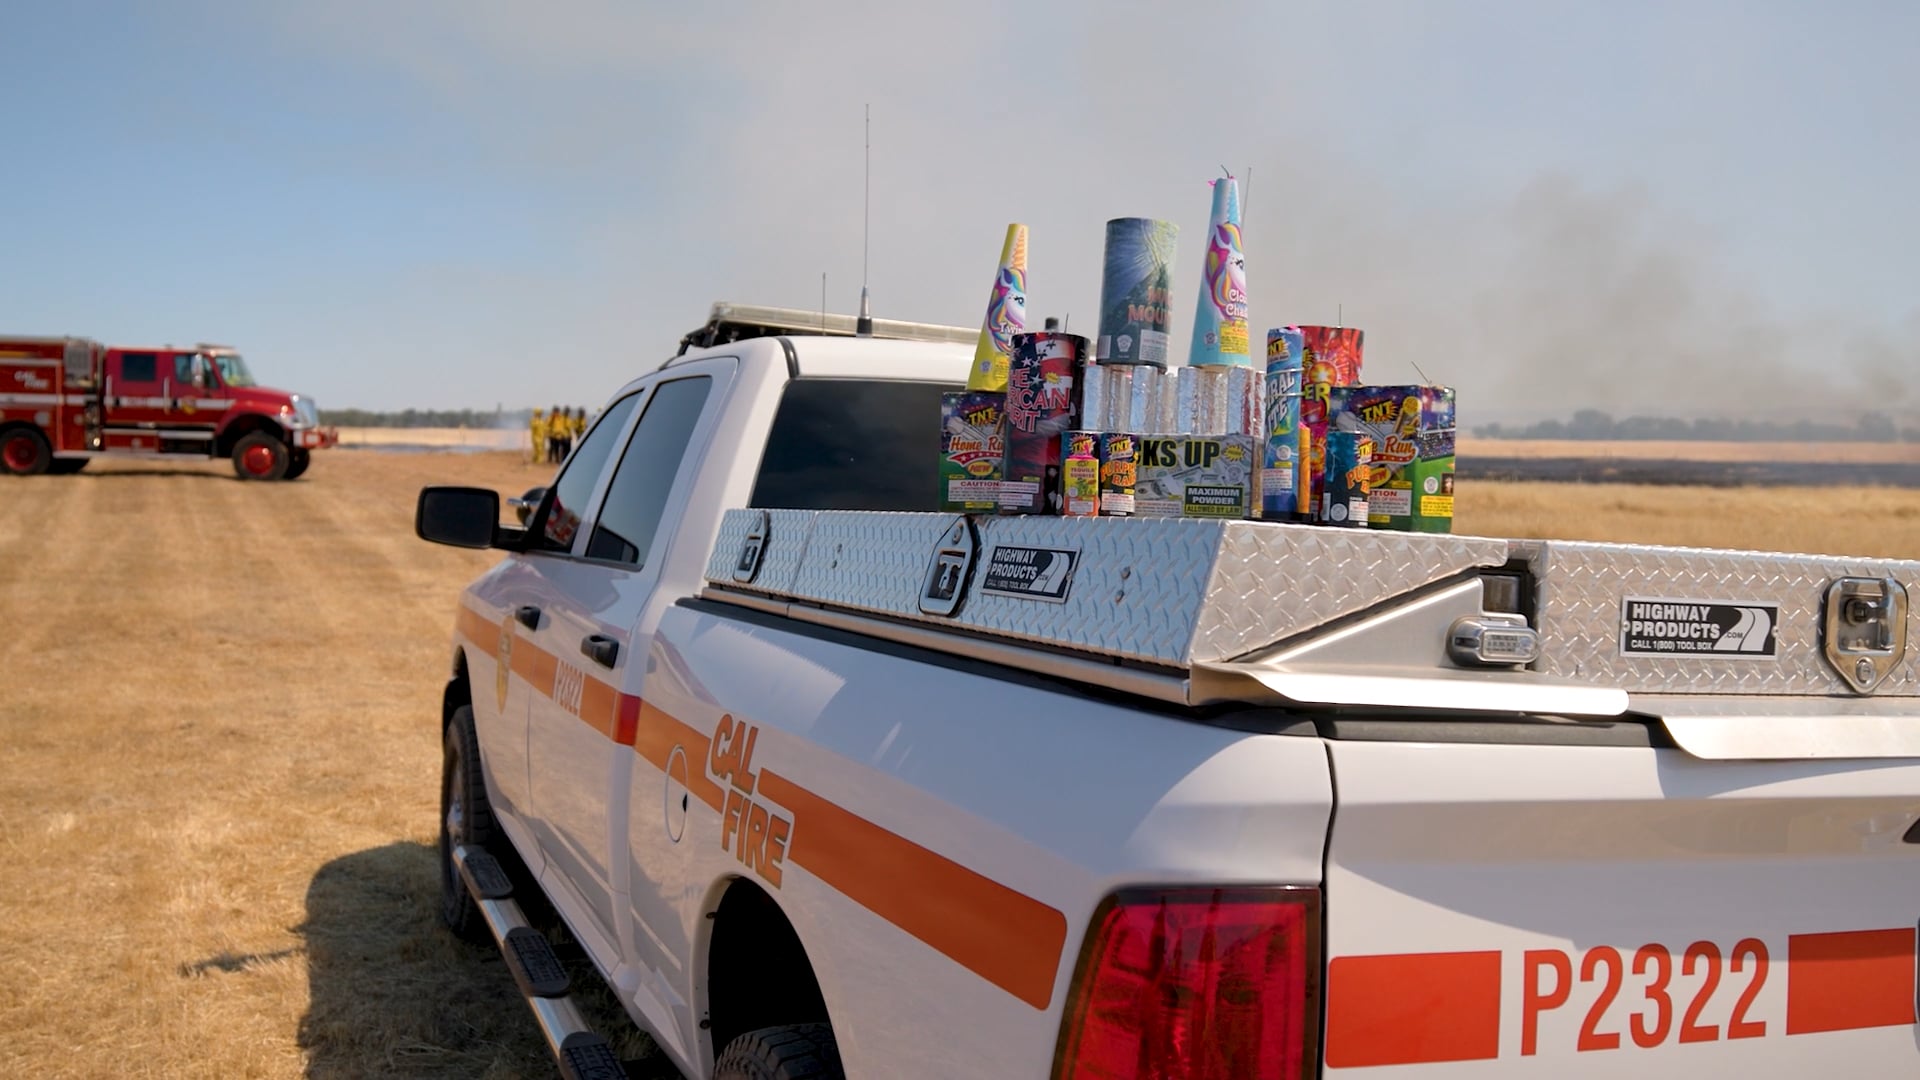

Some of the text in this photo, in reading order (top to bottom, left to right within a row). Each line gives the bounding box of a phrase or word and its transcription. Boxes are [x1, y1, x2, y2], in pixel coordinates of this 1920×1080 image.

[1008, 386, 1070, 409] RICAN
[969, 408, 995, 426] TNT
[1362, 401, 1393, 423] TNT
[950, 435, 1003, 453] Home Ru
[1110, 439, 1130, 453] TNT
[1359, 442, 1372, 457] TN
[1137, 440, 1219, 468] KS UP
[1345, 465, 1370, 490] PUR
[1187, 487, 1240, 497] MAXIMUM
[1192, 496, 1235, 505] POWDER
[994, 548, 1038, 564] HIGHWAY
[989, 563, 1038, 580] PRODUCTS
[1632, 603, 1711, 621] HIGHWAY
[1631, 621, 1721, 639] PRODUCTS
[1631, 639, 1651, 649] CALL
[1677, 641, 1696, 650] TOOL
[1698, 642, 1712, 651] BOX
[711, 713, 759, 796] CAL
[722, 788, 791, 890] FIRE
[1521, 938, 1770, 1056] P2322
